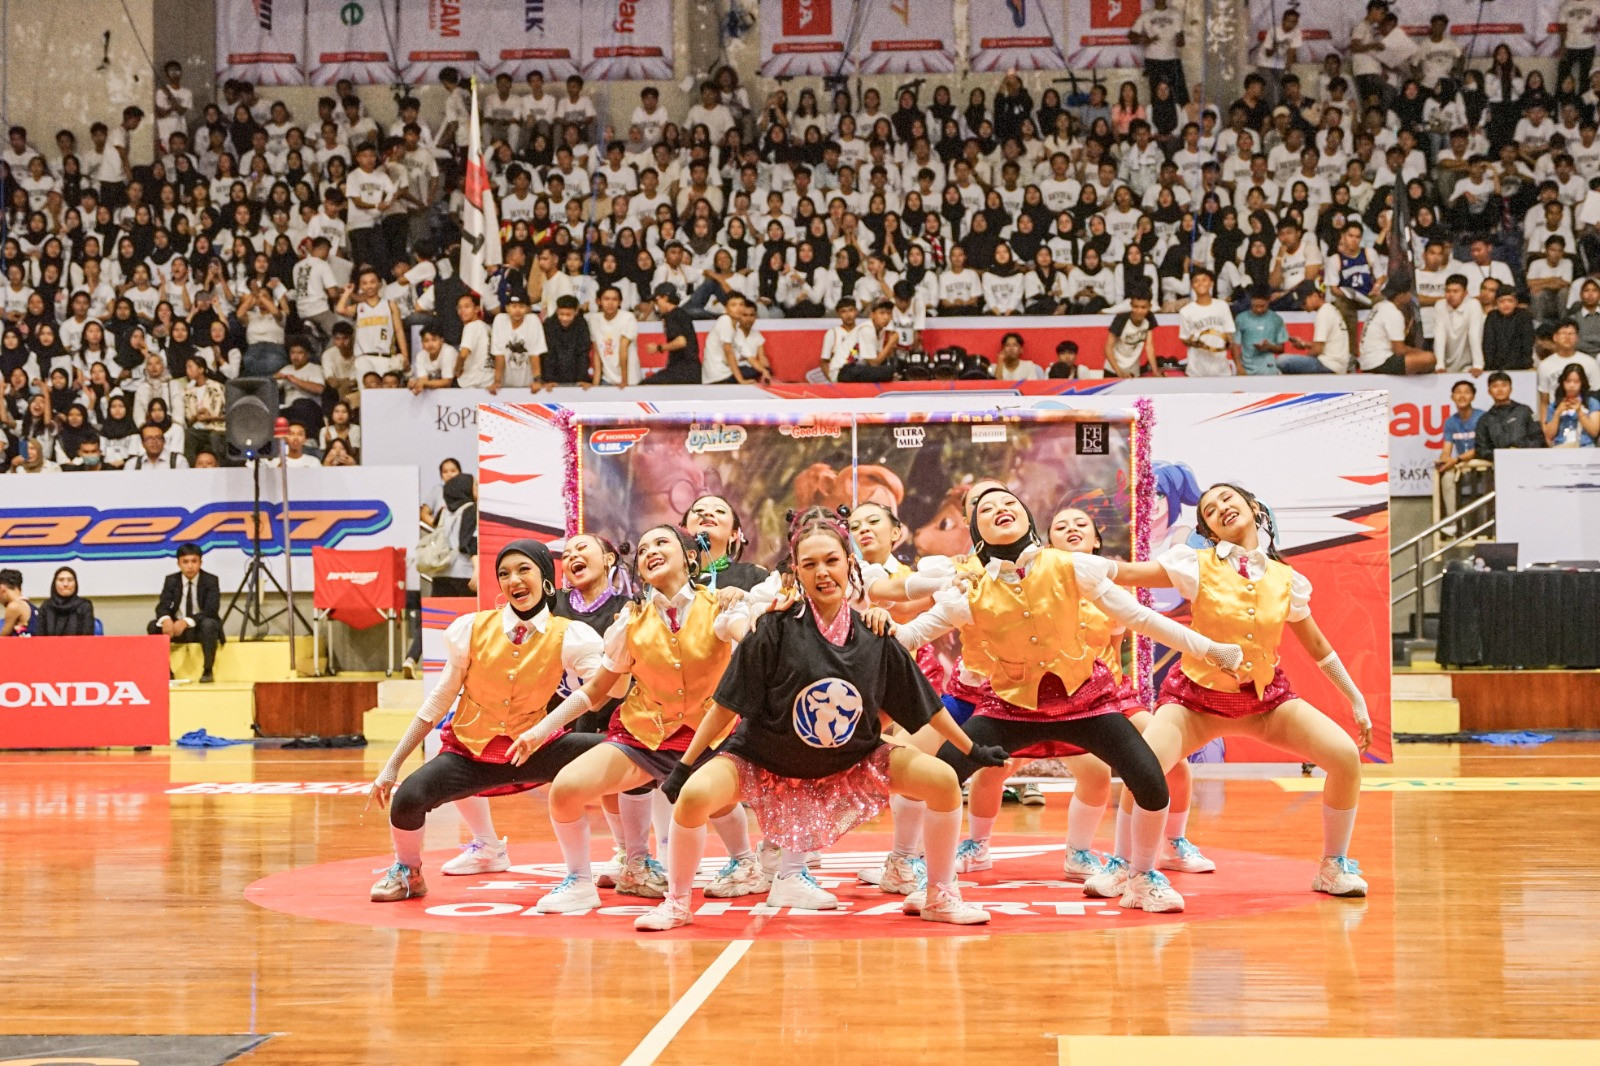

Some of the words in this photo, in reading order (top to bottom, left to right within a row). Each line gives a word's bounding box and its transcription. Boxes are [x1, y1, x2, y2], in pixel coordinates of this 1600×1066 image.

[612, 0, 639, 33] ay
[435, 404, 478, 432] KOPI
[605, 433, 638, 441] HONDA
[792, 424, 818, 437] Good
[820, 425, 840, 438] Day
[895, 428, 923, 436] ULTRA
[689, 430, 742, 448] DANCE
[899, 438, 922, 446] MILK
[1399, 468, 1431, 481] RASA
[0, 681, 151, 708] ONDA
